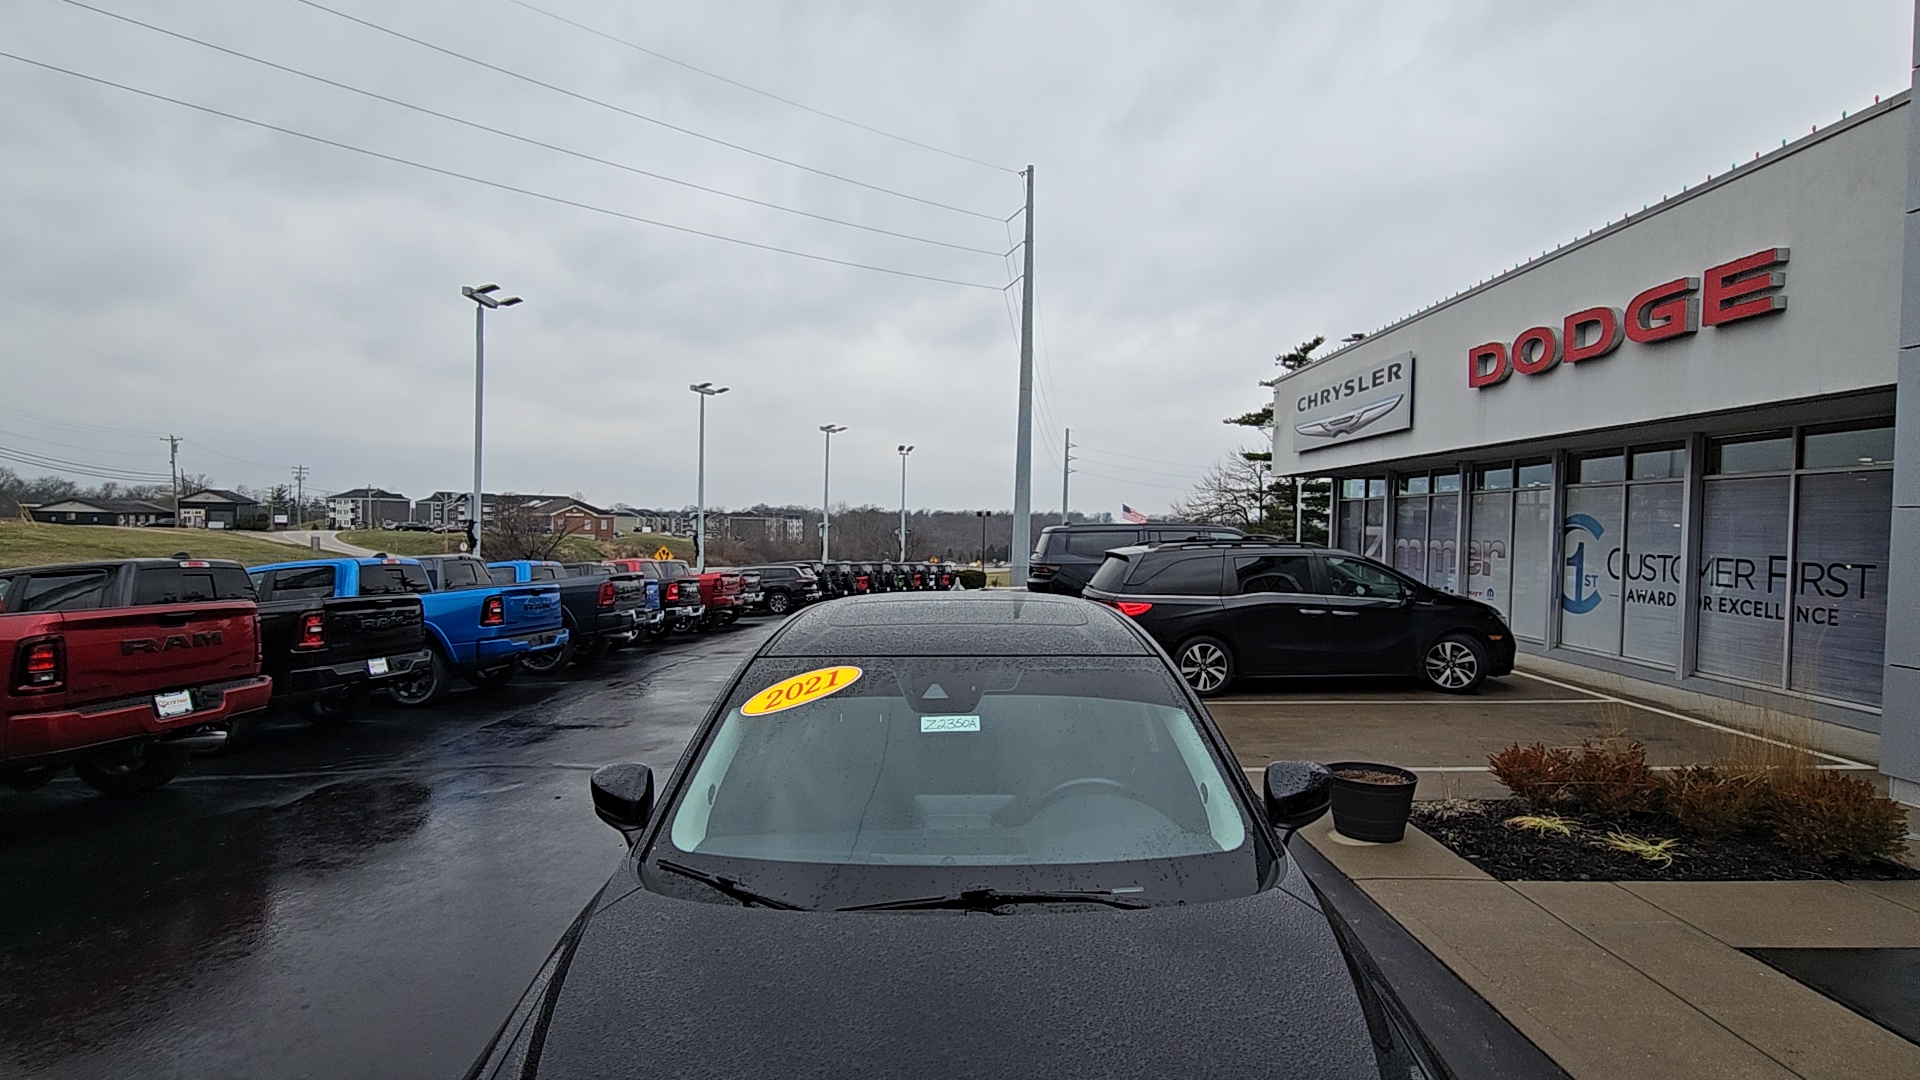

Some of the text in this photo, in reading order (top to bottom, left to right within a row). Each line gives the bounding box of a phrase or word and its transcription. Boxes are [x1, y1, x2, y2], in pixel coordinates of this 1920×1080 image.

[1468, 247, 1790, 389] DODGE
[1297, 363, 1402, 412] CHRYSLER
[1358, 525, 1506, 577] Zmmer
[1626, 588, 1677, 607] AWARD
[1718, 597, 1840, 627] EXCELLNCE
[120, 630, 223, 656] RAM
[764, 670, 839, 710] 2021
[923, 718, 977, 730] Z2350A
